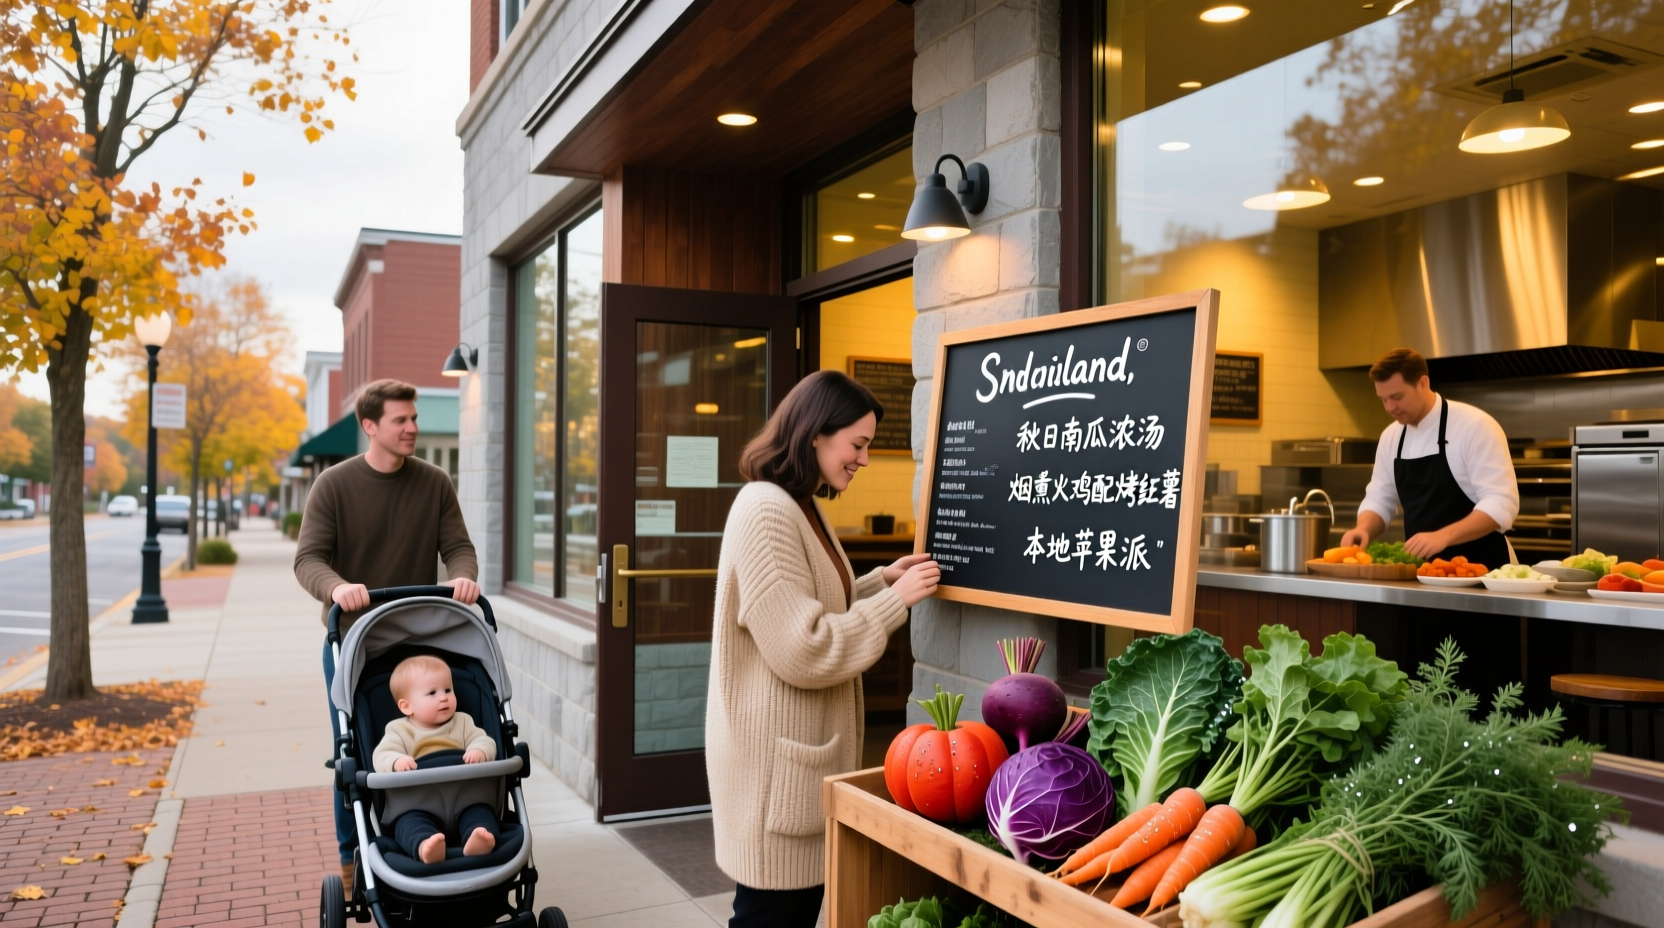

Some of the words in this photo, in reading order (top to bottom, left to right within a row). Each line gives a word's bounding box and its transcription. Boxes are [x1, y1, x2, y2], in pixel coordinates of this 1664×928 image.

[1016, 414, 1165, 453] 秋日南瓜浓汤
